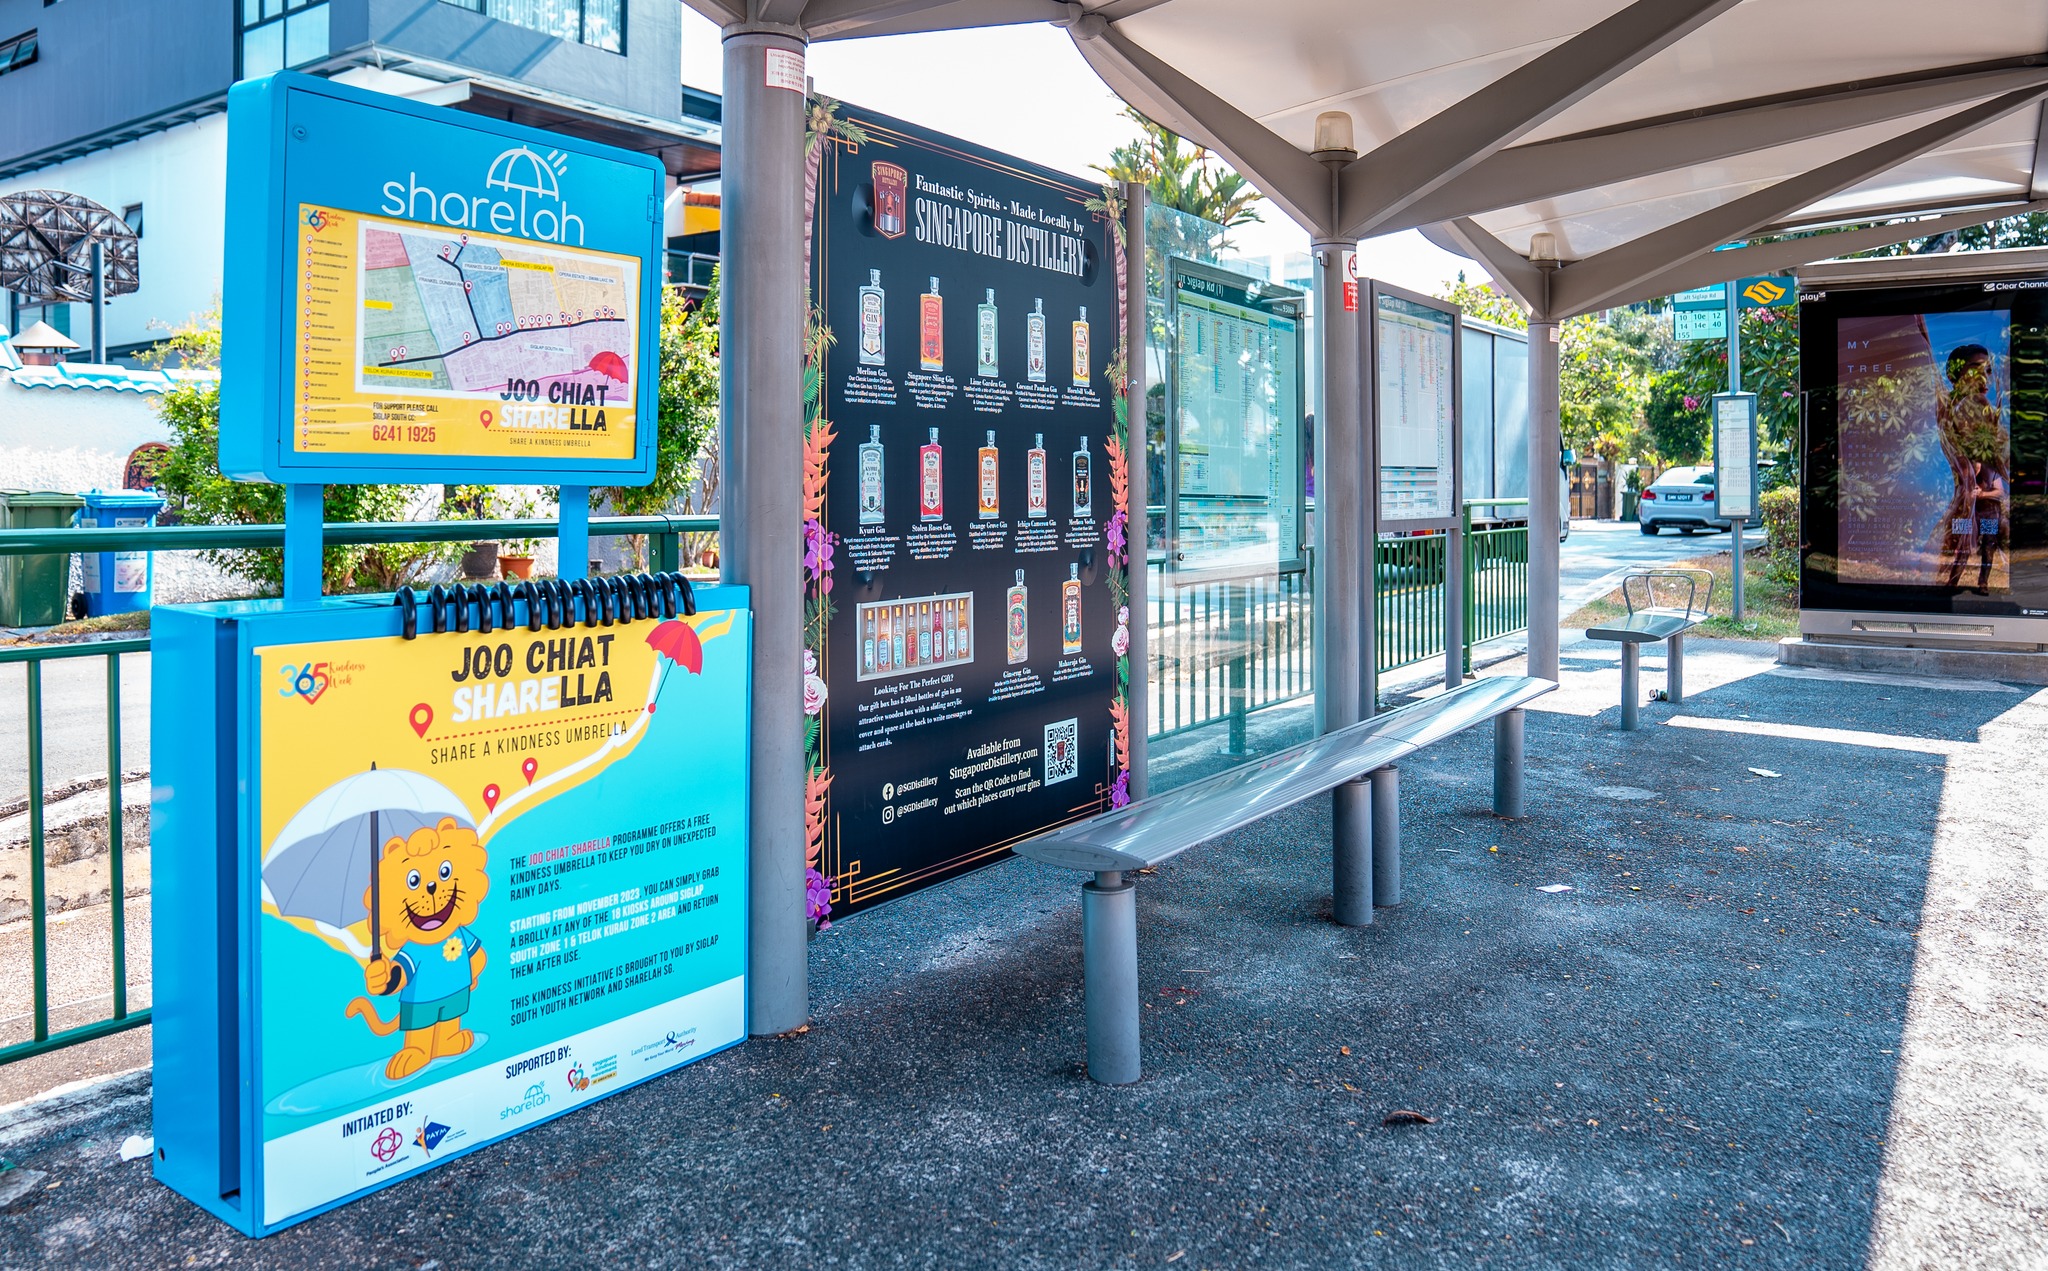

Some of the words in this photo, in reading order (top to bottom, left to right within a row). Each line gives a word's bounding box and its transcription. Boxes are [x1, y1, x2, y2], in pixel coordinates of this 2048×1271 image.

[877, 166, 902, 181] SINGAPORE
[382, 171, 585, 246] sharelah
[916, 174, 964, 201] Fantastic
[967, 188, 1000, 210] Spirits
[1011, 200, 1036, 221] Made
[1039, 209, 1071, 233] Locally
[1074, 218, 1085, 236] by
[300, 208, 327, 233] 365
[915, 197, 1001, 258] SINGAPORE
[1006, 220, 1085, 277] DISTILLERY
[1692, 293, 1708, 301] Siglap
[1800, 294, 1818, 302] play
[1847, 341, 1869, 349] MY
[857, 367, 877, 376] Merlion
[878, 369, 887, 377] Gin
[907, 371, 931, 384] Singapore
[932, 374, 944, 384] Sling
[946, 375, 954, 383] Gin
[1848, 364, 1892, 373] TREE
[500, 378, 539, 402] JOO
[548, 382, 608, 406] CHIAT
[384, 403, 405, 411] SUPPORT
[406, 403, 425, 412] PLEASE
[426, 404, 438, 412] CALL
[391, 413, 407, 421] SOUTH
[500, 404, 606, 431] SHARELLA
[373, 425, 401, 441] 6241
[408, 426, 436, 442] 1925
[535, 438, 562, 446] KINDNESS
[859, 526, 875, 536] Kyuri
[912, 524, 928, 532] Stolen
[970, 522, 986, 531] Orange
[451, 643, 513, 682] JOO
[526, 634, 615, 674] CHIAT
[279, 662, 329, 705] 365
[329, 660, 365, 674] Kindness
[874, 686, 898, 695] Looking
[899, 683, 909, 691] For
[910, 681, 920, 689] The
[922, 677, 940, 687] Perfect
[941, 674, 954, 683] Gift?
[451, 671, 613, 723] SHARELLA
[431, 743, 476, 764] SHARE
[483, 741, 491, 756] A
[497, 731, 560, 754] KINDNESS
[566, 721, 627, 743] UMBRELLA
[967, 742, 1001, 760] Available
[1003, 738, 1021, 750] from
[949, 748, 1038, 780] SingaporeDistillery.com
[897, 776, 938, 796] @SGDistillery
[955, 787, 971, 798] Scan
[972, 782, 983, 793] the
[984, 779, 994, 791] QR
[994, 776, 1010, 786] Code
[1011, 773, 1017, 781] to
[1019, 768, 1031, 779] find
[897, 797, 938, 817] @SGDistillery
[944, 804, 956, 815] out
[957, 797, 977, 812] which
[978, 791, 998, 807] places
[999, 787, 1015, 799] carry
[1016, 783, 1027, 793] our
[1028, 778, 1041, 793] gins
[510, 855, 526, 870] THE
[529, 850, 543, 866] JOO
[546, 846, 569, 862] CHIAT
[571, 837, 610, 858] SHARELLA
[613, 827, 658, 847] PROGRAMME
[660, 820, 685, 834] OFFERS
[687, 818, 692, 828] A
[694, 814, 710, 826] FREE
[510, 866, 551, 885] KINDNESS
[554, 857, 595, 876] UMBRELLA
[597, 853, 607, 864] TO
[609, 847, 628, 862] KEEP
[630, 843, 644, 857] YOU
[646, 839, 660, 853] DRY
[662, 836, 672, 848] ON
[674, 826, 716, 846] UNEXPECTED
[510, 885, 535, 901] RAINY
[538, 879, 562, 895] DAYS.
[510, 915, 550, 933] STARTING
[553, 905, 574, 923] FROM
[577, 894, 618, 916] NOVEMBER
[644, 884, 657, 900] YOU
[660, 879, 674, 892] CAN
[676, 871, 700, 888] SIMPLY
[702, 866, 720, 881] GRAB
[631, 1047, 643, 1056] Land
[644, 1039, 665, 1051] Transport
[676, 1027, 697, 1039] Authority
[506, 1051, 555, 1079] SUPPORTED
[558, 1045, 571, 1060] BY:
[500, 1092, 550, 1120] sharelah
[343, 1107, 394, 1138] INITIATED
[397, 1101, 413, 1119] BY:
[426, 1128, 447, 1140] PAYM
[385, 1155, 409, 1168] Association
